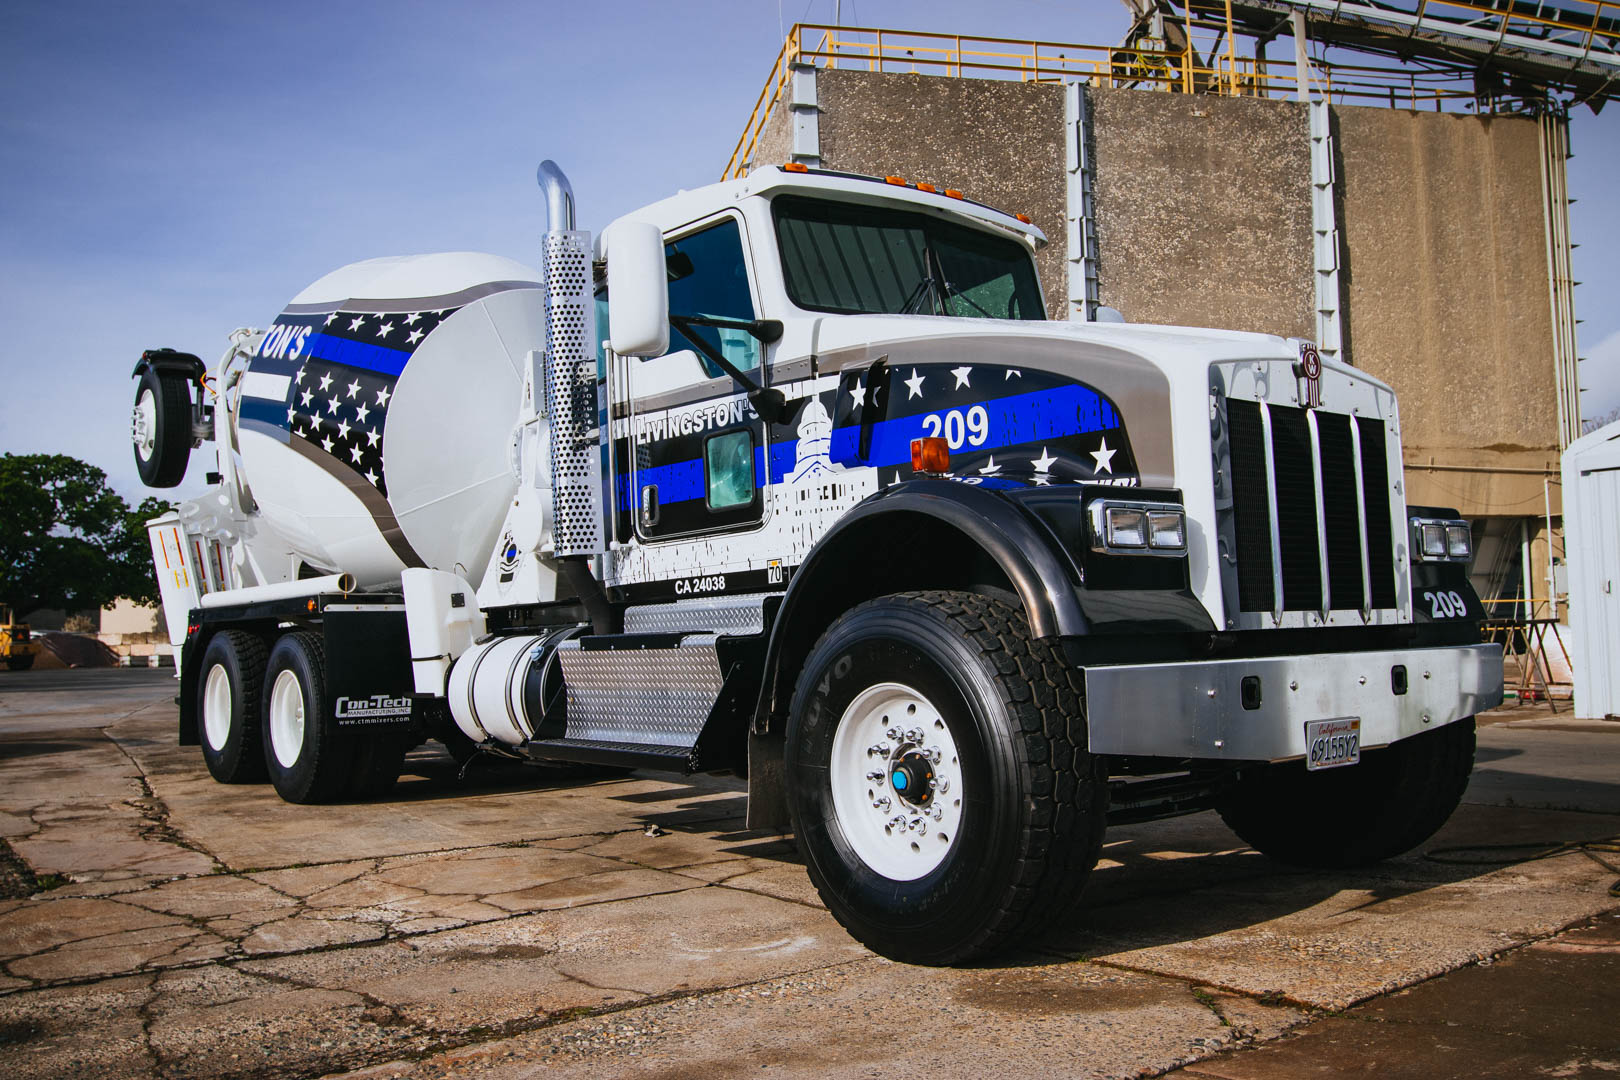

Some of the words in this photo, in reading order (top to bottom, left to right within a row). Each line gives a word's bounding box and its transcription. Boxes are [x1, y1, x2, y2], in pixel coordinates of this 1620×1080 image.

[922, 405, 988, 450] 209
[769, 565, 781, 582] 70
[675, 580, 692, 595] CA
[693, 576, 726, 593] 24038
[1423, 591, 1467, 618] 209
[338, 716, 410, 725] www.ctmmixers.com
[1311, 734, 1357, 762] 69155Y2
